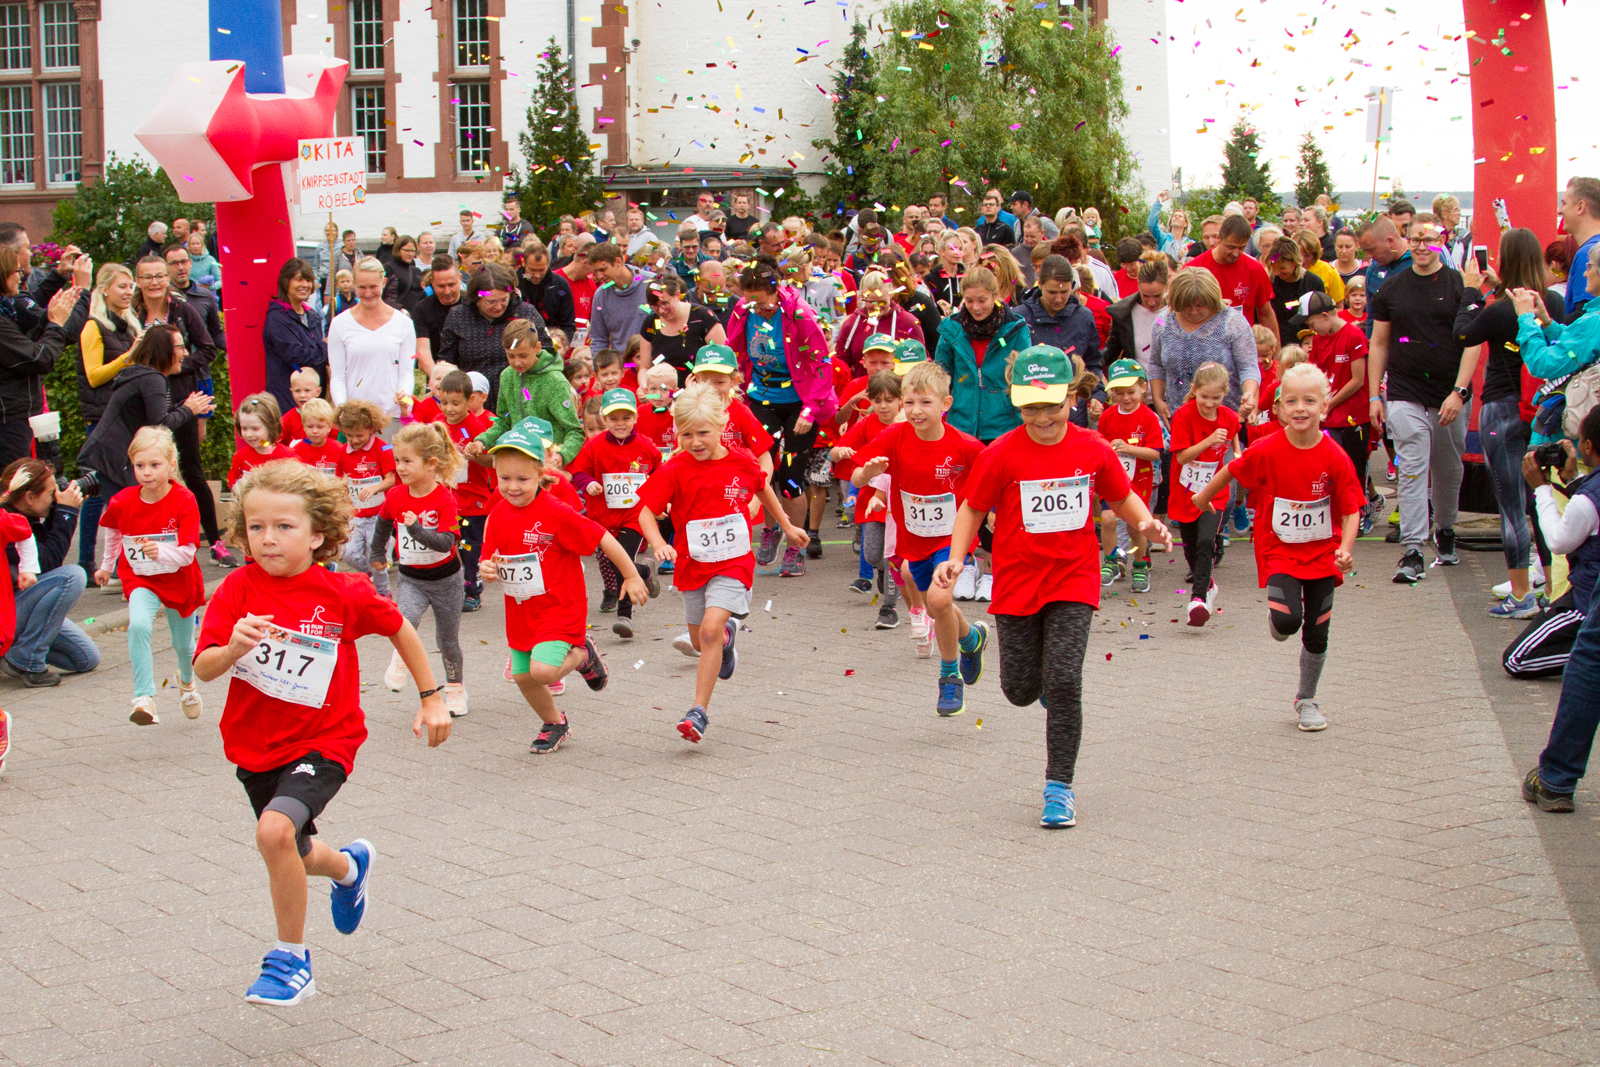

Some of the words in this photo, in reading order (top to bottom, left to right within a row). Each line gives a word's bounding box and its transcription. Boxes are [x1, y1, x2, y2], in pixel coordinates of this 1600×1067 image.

[314, 141, 354, 161] KITA
[302, 171, 365, 190] KNIRPSENSTADT
[319, 192, 356, 208] RÖBEL
[1187, 467, 1212, 483] 31.5
[606, 483, 641, 495] 206.7
[1031, 491, 1083, 513] 206.1
[910, 506, 943, 521] 31.3
[1280, 510, 1325, 527] 210.1
[700, 528, 736, 547] 31.5
[498, 566, 533, 581] 07.3
[299, 623, 310, 635] 11
[255, 643, 314, 676] 31.7
